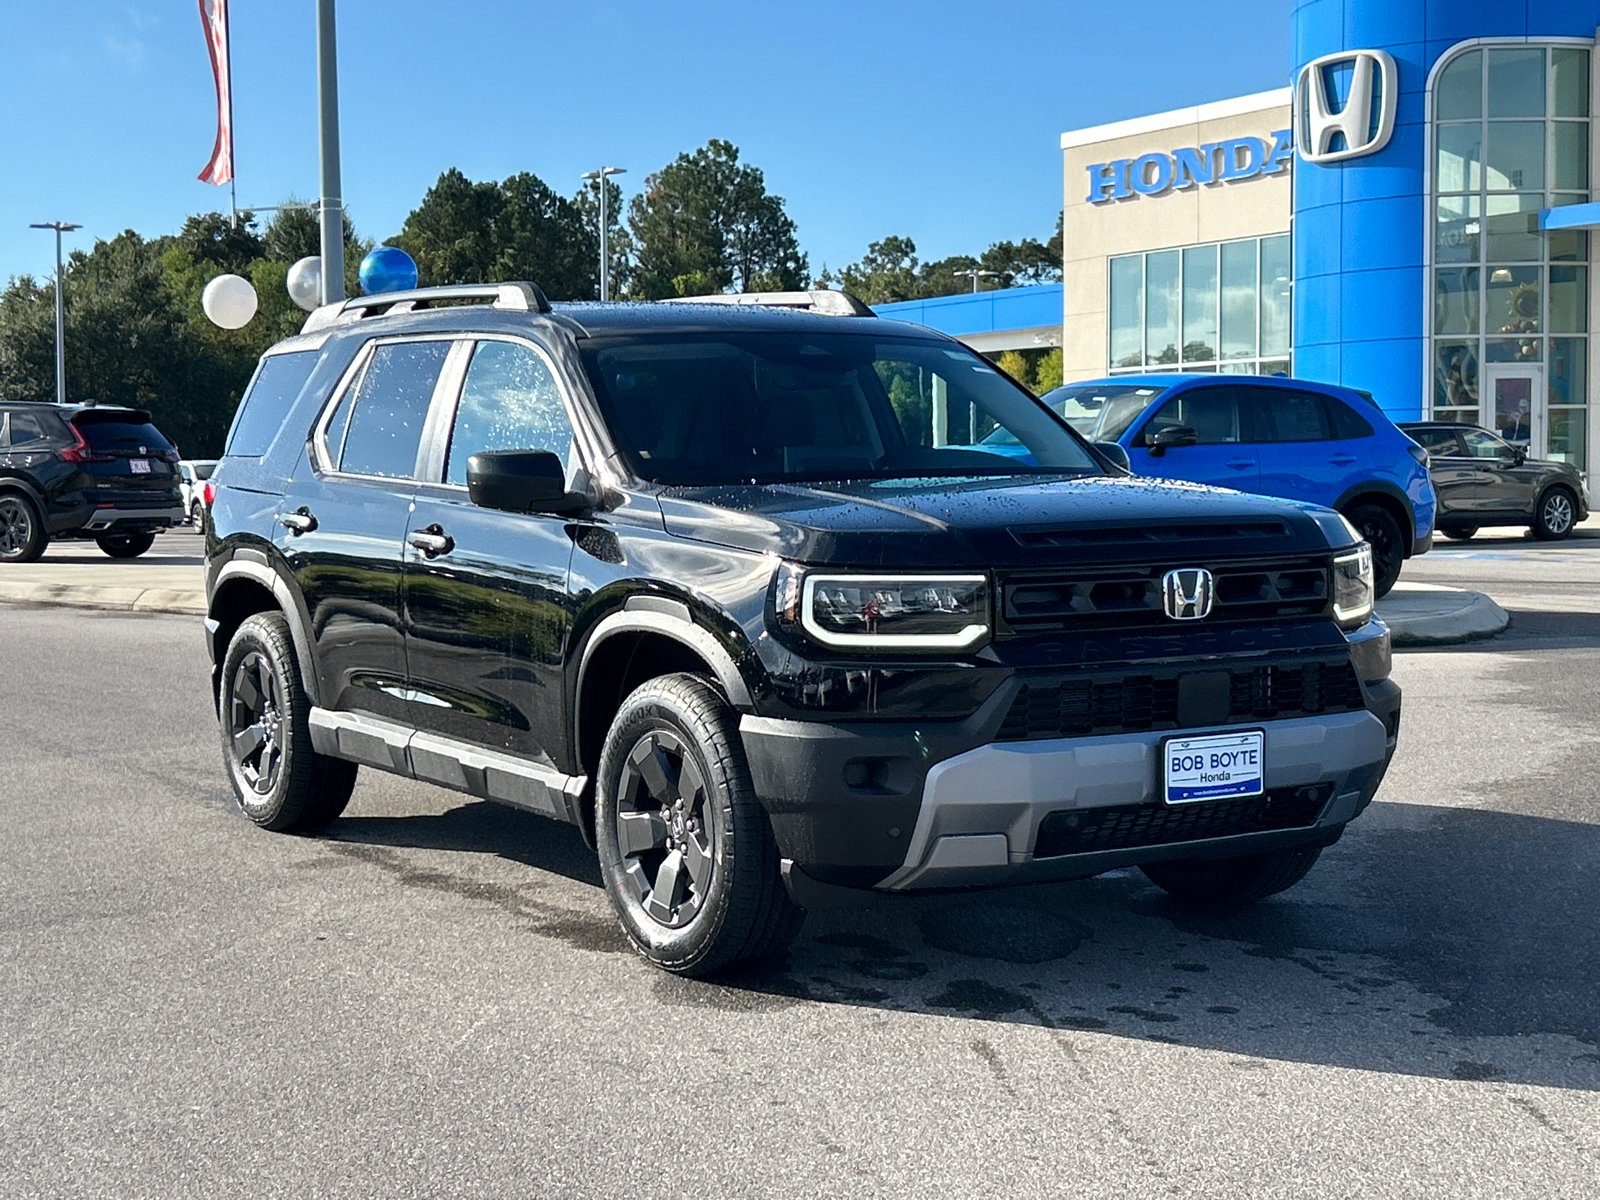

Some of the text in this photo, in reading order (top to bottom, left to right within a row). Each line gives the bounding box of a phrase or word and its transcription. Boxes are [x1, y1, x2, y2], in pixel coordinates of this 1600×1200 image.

[1085, 129, 1292, 203] HONDA
[1172, 749, 1258, 772] BOB BOYTE
[1200, 771, 1231, 783] Honda
